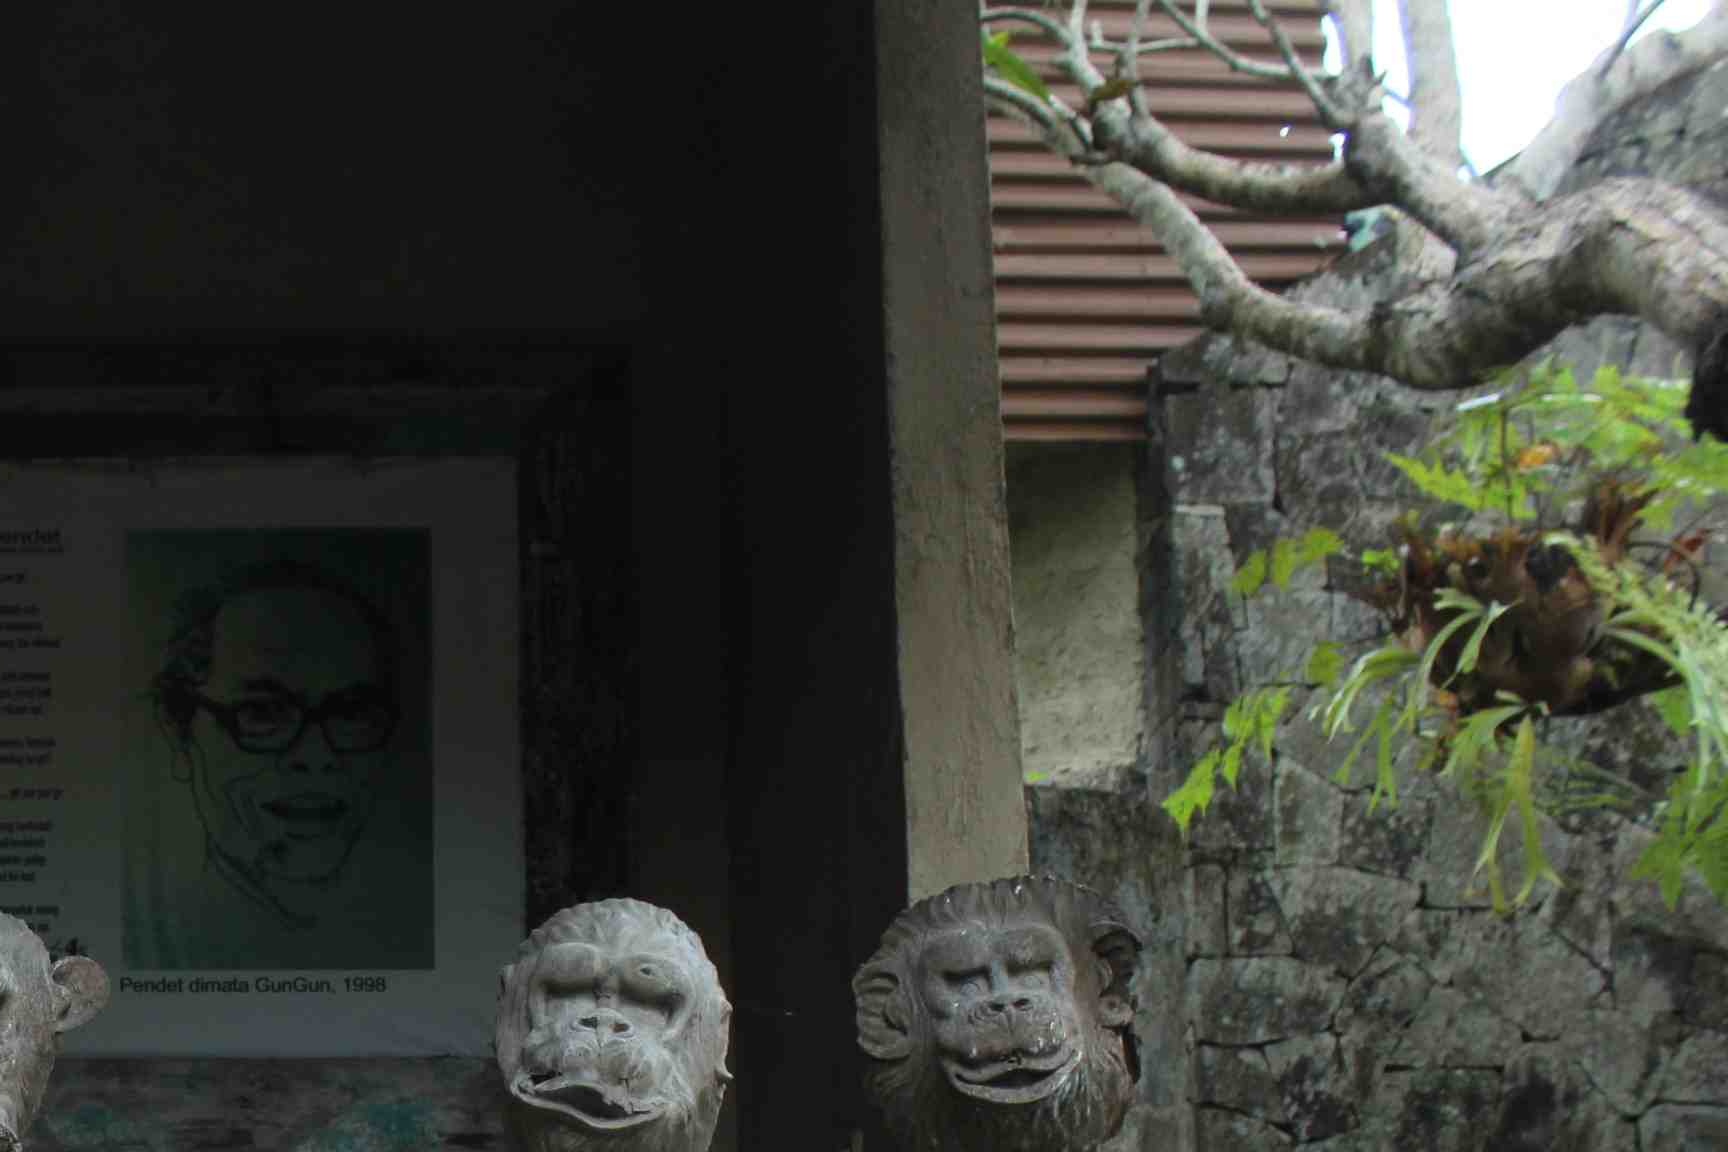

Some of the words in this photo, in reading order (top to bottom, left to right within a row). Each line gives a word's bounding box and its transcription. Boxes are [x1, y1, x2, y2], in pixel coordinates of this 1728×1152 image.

[119, 976, 184, 993] Pendet
[188, 976, 250, 993] dimata
[255, 976, 337, 995] GunGun,
[343, 976, 388, 993] 1998
